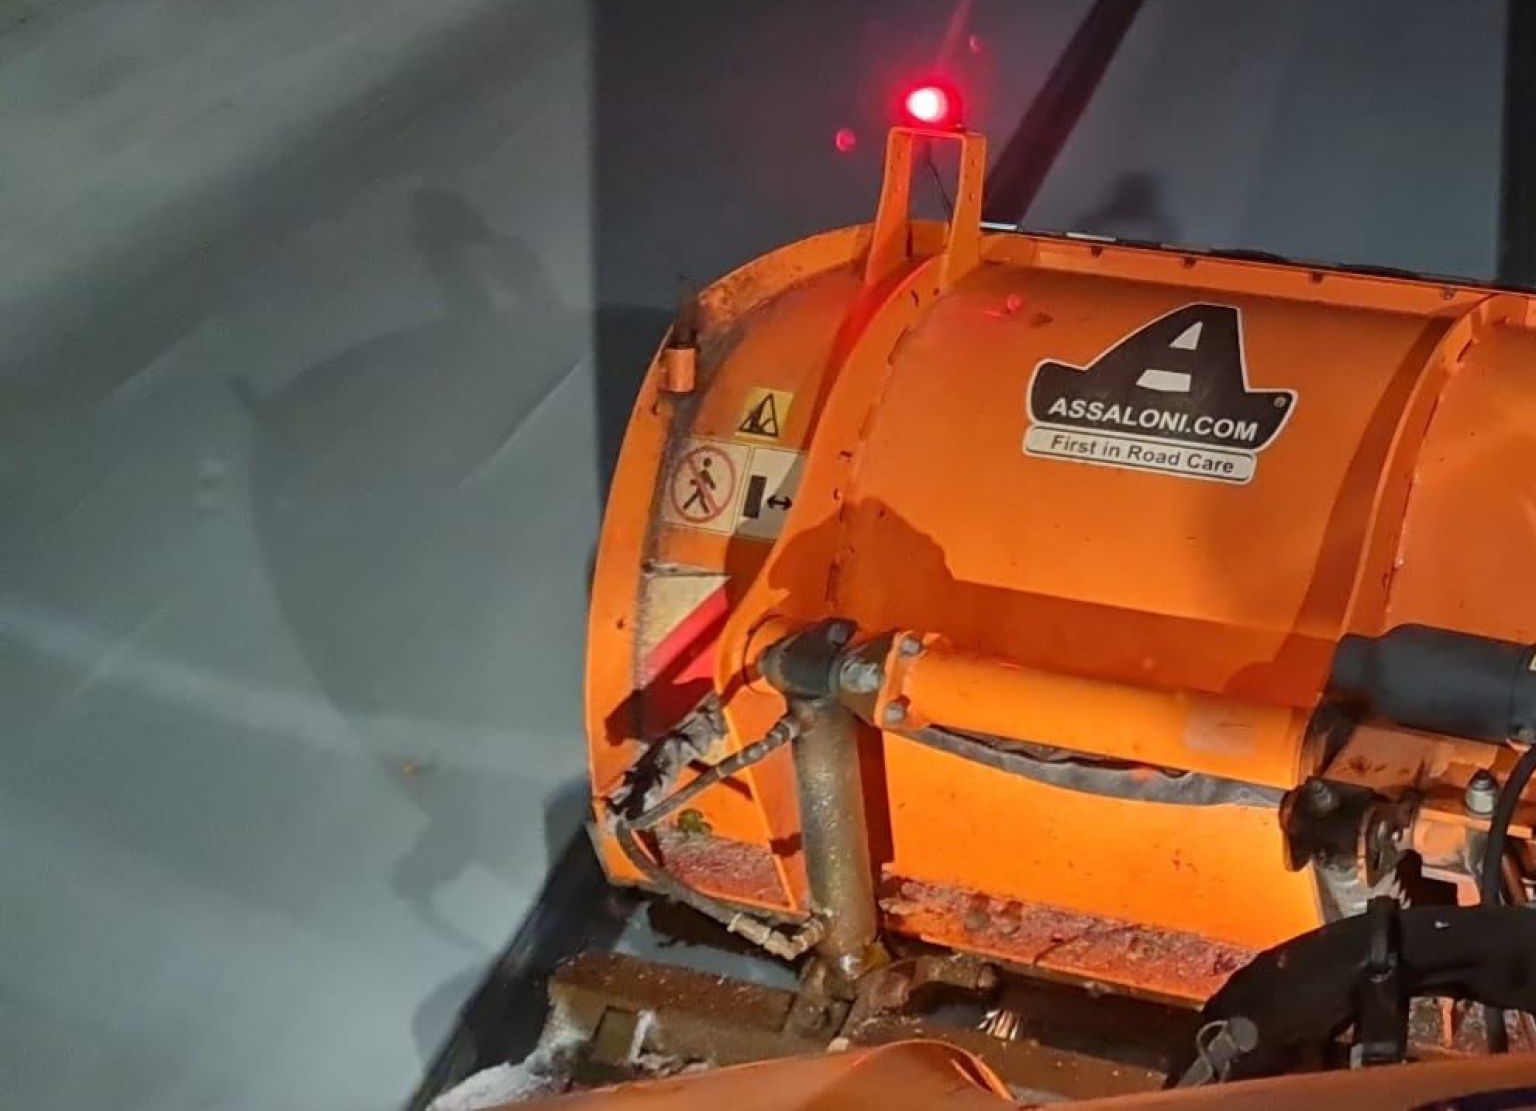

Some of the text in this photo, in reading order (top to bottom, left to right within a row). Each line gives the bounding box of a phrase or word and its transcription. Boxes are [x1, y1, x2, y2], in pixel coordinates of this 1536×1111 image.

[1048, 397, 1258, 441] ASSALONI.COM
[1050, 434, 1235, 475] First in Road Care
